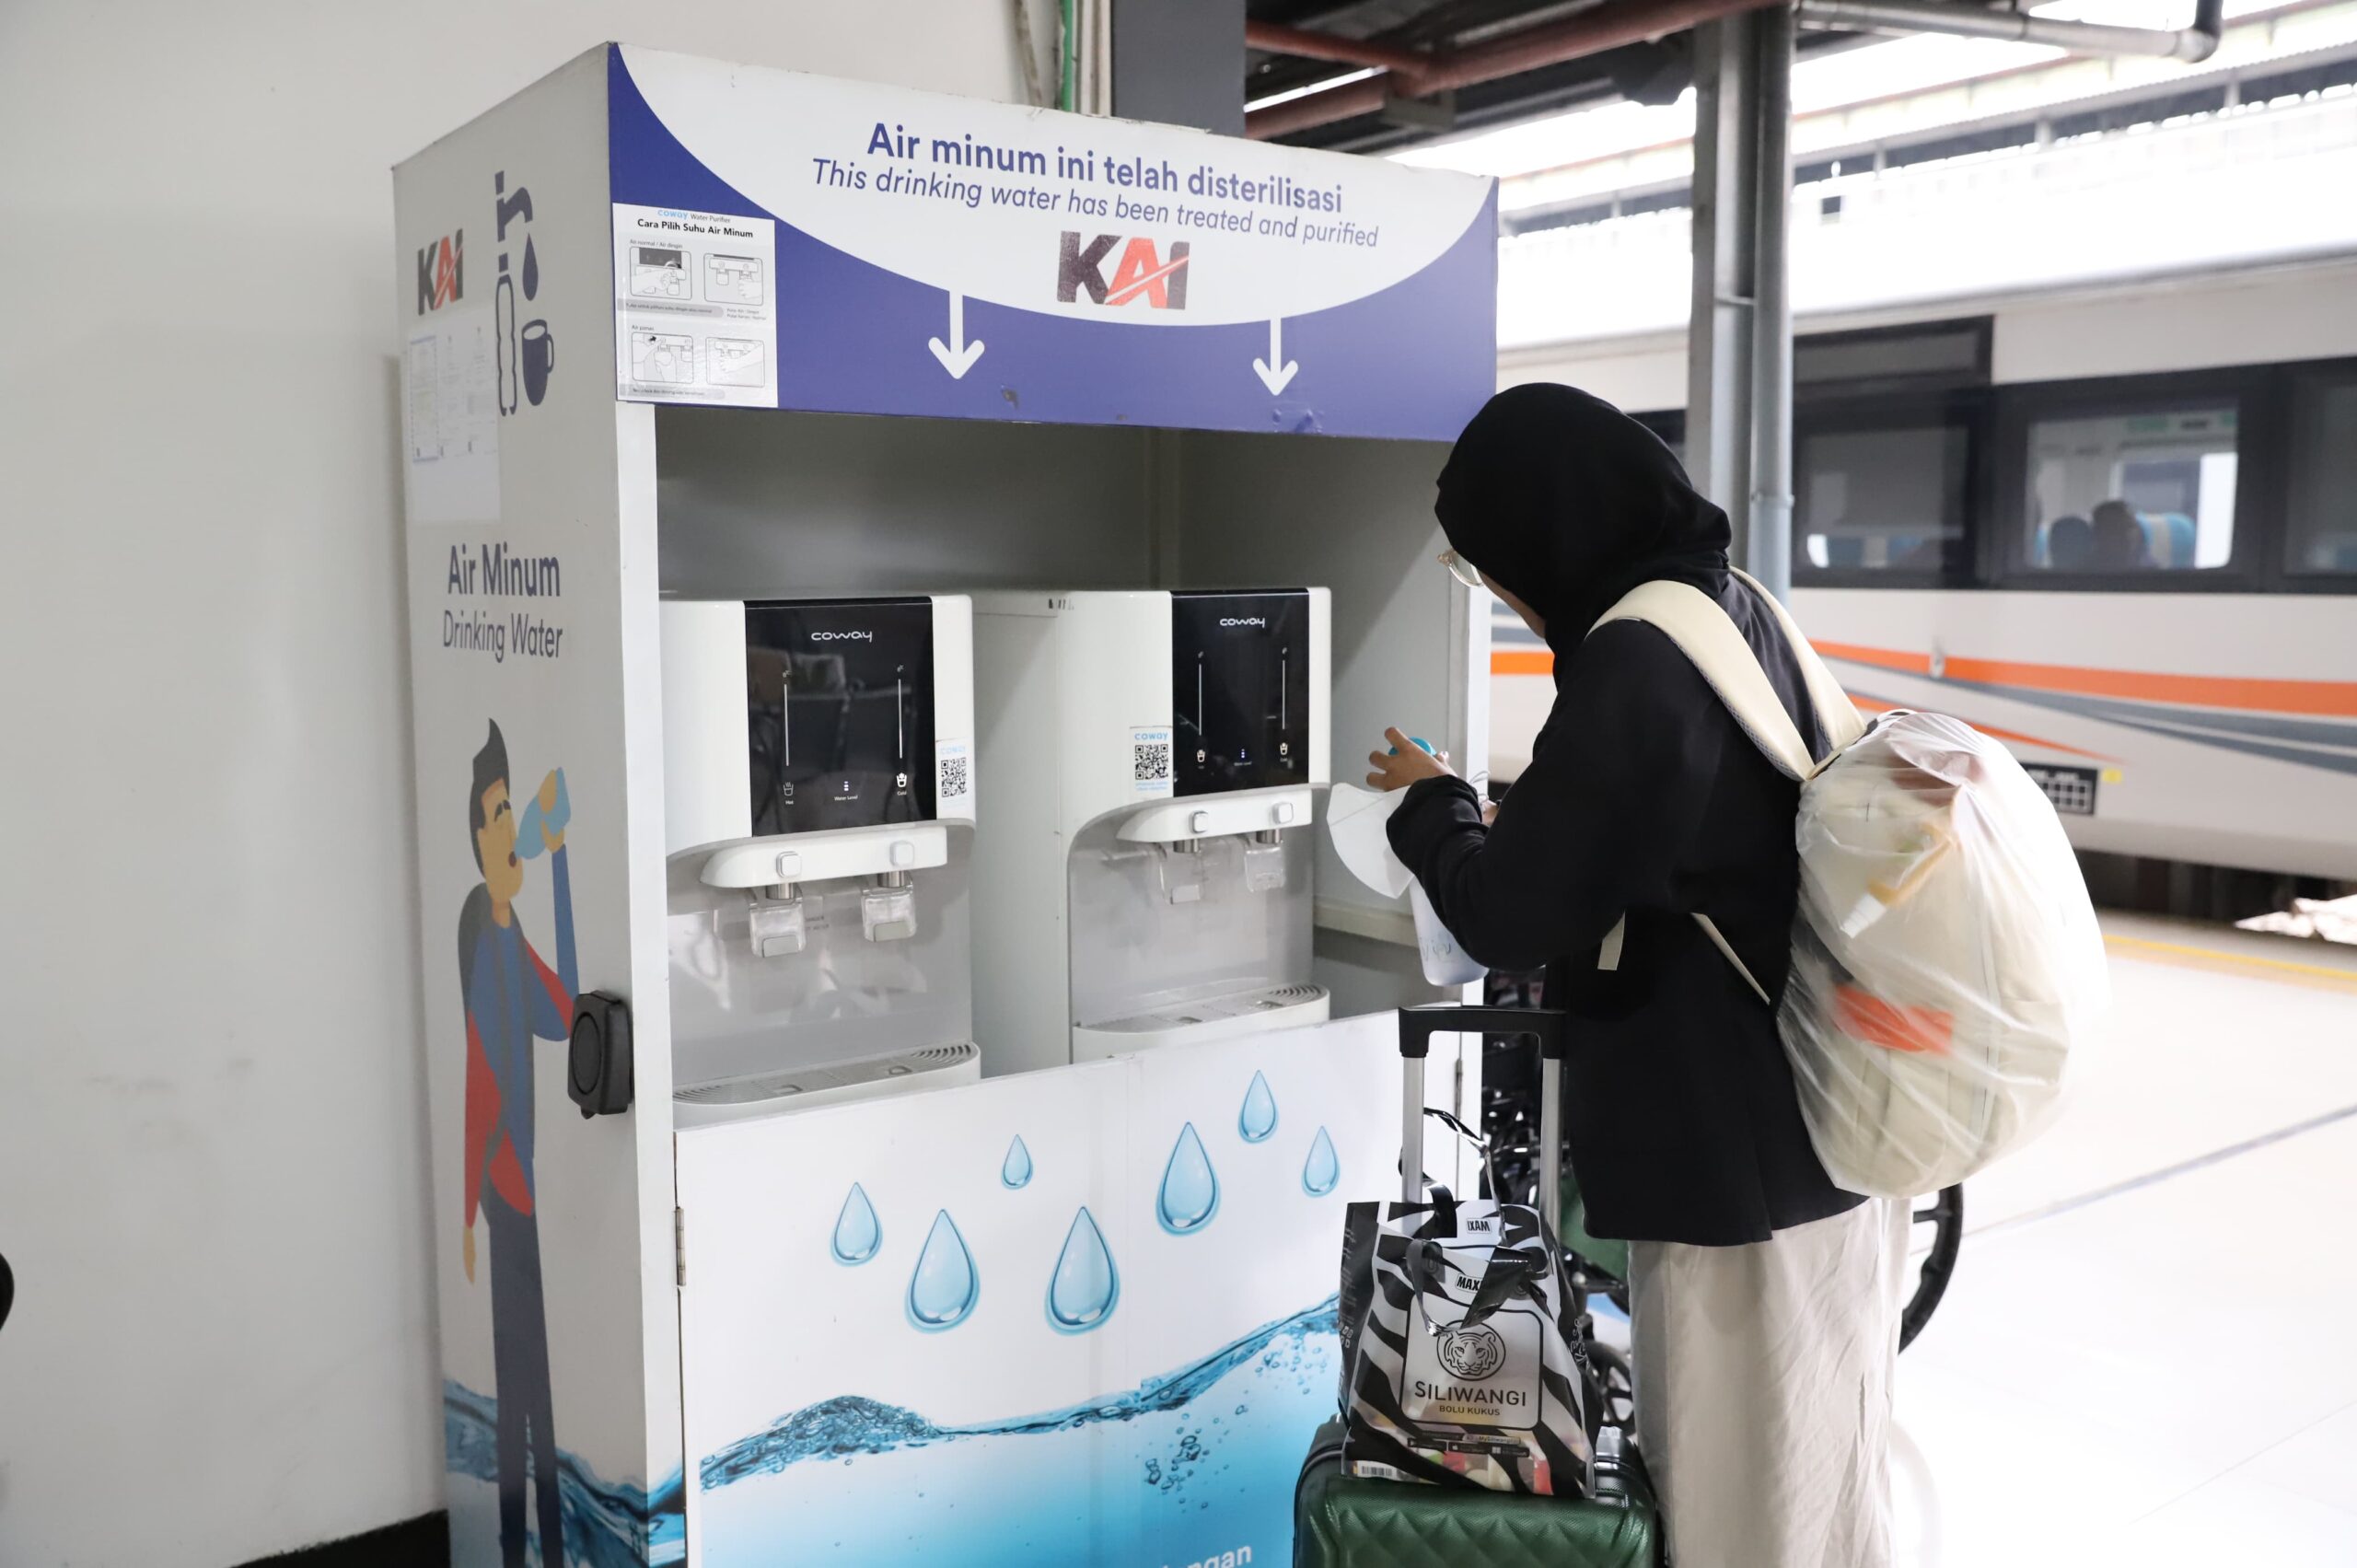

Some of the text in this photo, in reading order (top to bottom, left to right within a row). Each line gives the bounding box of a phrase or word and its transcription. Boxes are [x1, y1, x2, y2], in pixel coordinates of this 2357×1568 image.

[867, 122, 1341, 213] Air minum ini telah disterilisasi
[813, 157, 1379, 248] This drinking water has been treated and purified
[637, 218, 754, 238] Cara Pilih Suhu Air Minum
[691, 213, 708, 221] Water
[709, 215, 731, 224] Purifier
[418, 228, 463, 316] KAI
[1057, 230, 1190, 310] KAI
[447, 540, 561, 597] Air Minum
[443, 610, 563, 663] Drinking Water
[1219, 617, 1266, 629] coway
[810, 631, 873, 643] coway
[1457, 1276, 1482, 1292] MAX
[1414, 1380, 1527, 1407] SILIWANGI
[1439, 1405, 1501, 1416] BOLU KUKUS
